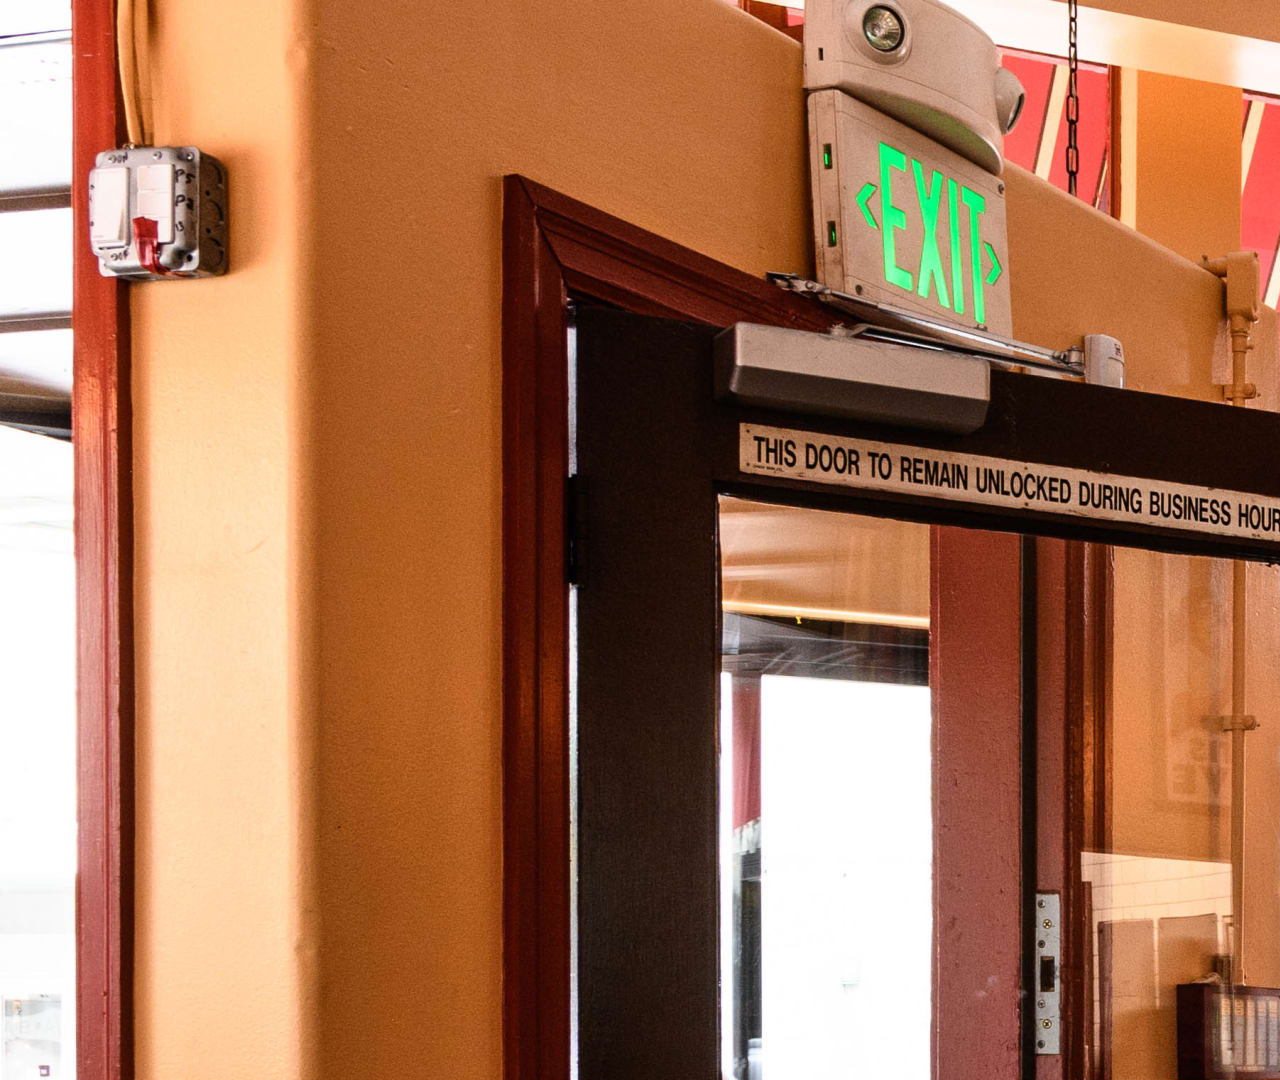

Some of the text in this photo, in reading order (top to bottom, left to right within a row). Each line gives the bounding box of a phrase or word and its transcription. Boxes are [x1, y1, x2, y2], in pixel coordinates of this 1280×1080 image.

[878, 141, 985, 324] EXIT
[753, 436, 796, 467] THIS
[805, 443, 860, 476] DOOR
[868, 452, 892, 480] TO
[900, 456, 968, 490] REMAIN
[976, 467, 1071, 504] UNLOCKED
[1079, 481, 1142, 514] DURING
[1150, 491, 1231, 526] BUSINESS
